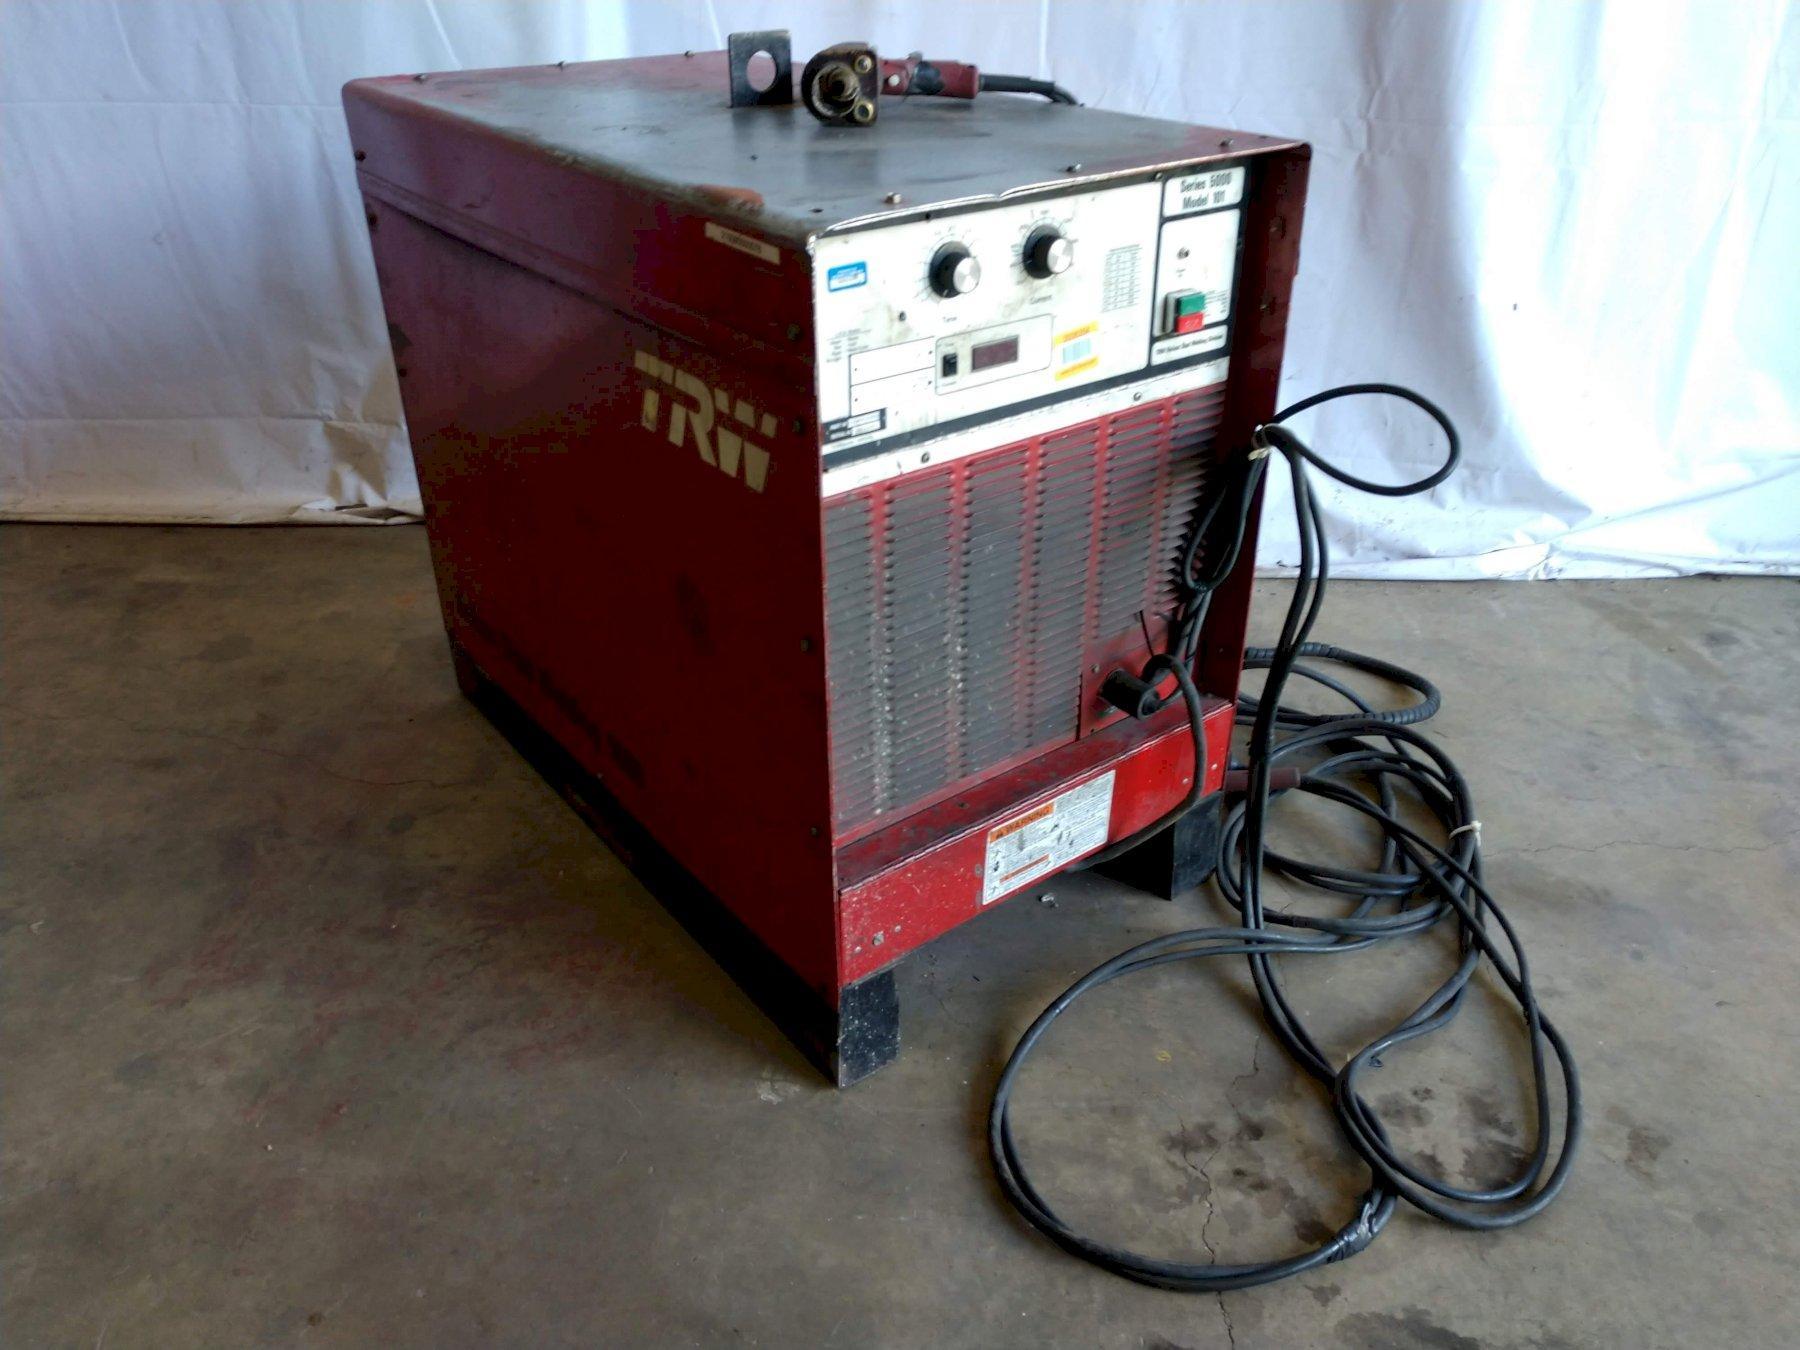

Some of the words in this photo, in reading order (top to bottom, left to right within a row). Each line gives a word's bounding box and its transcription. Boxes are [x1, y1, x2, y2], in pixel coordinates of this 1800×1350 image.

[1181, 177, 1206, 193] Series
[1183, 193, 1209, 209] Model
[634, 350, 778, 494] TRW
